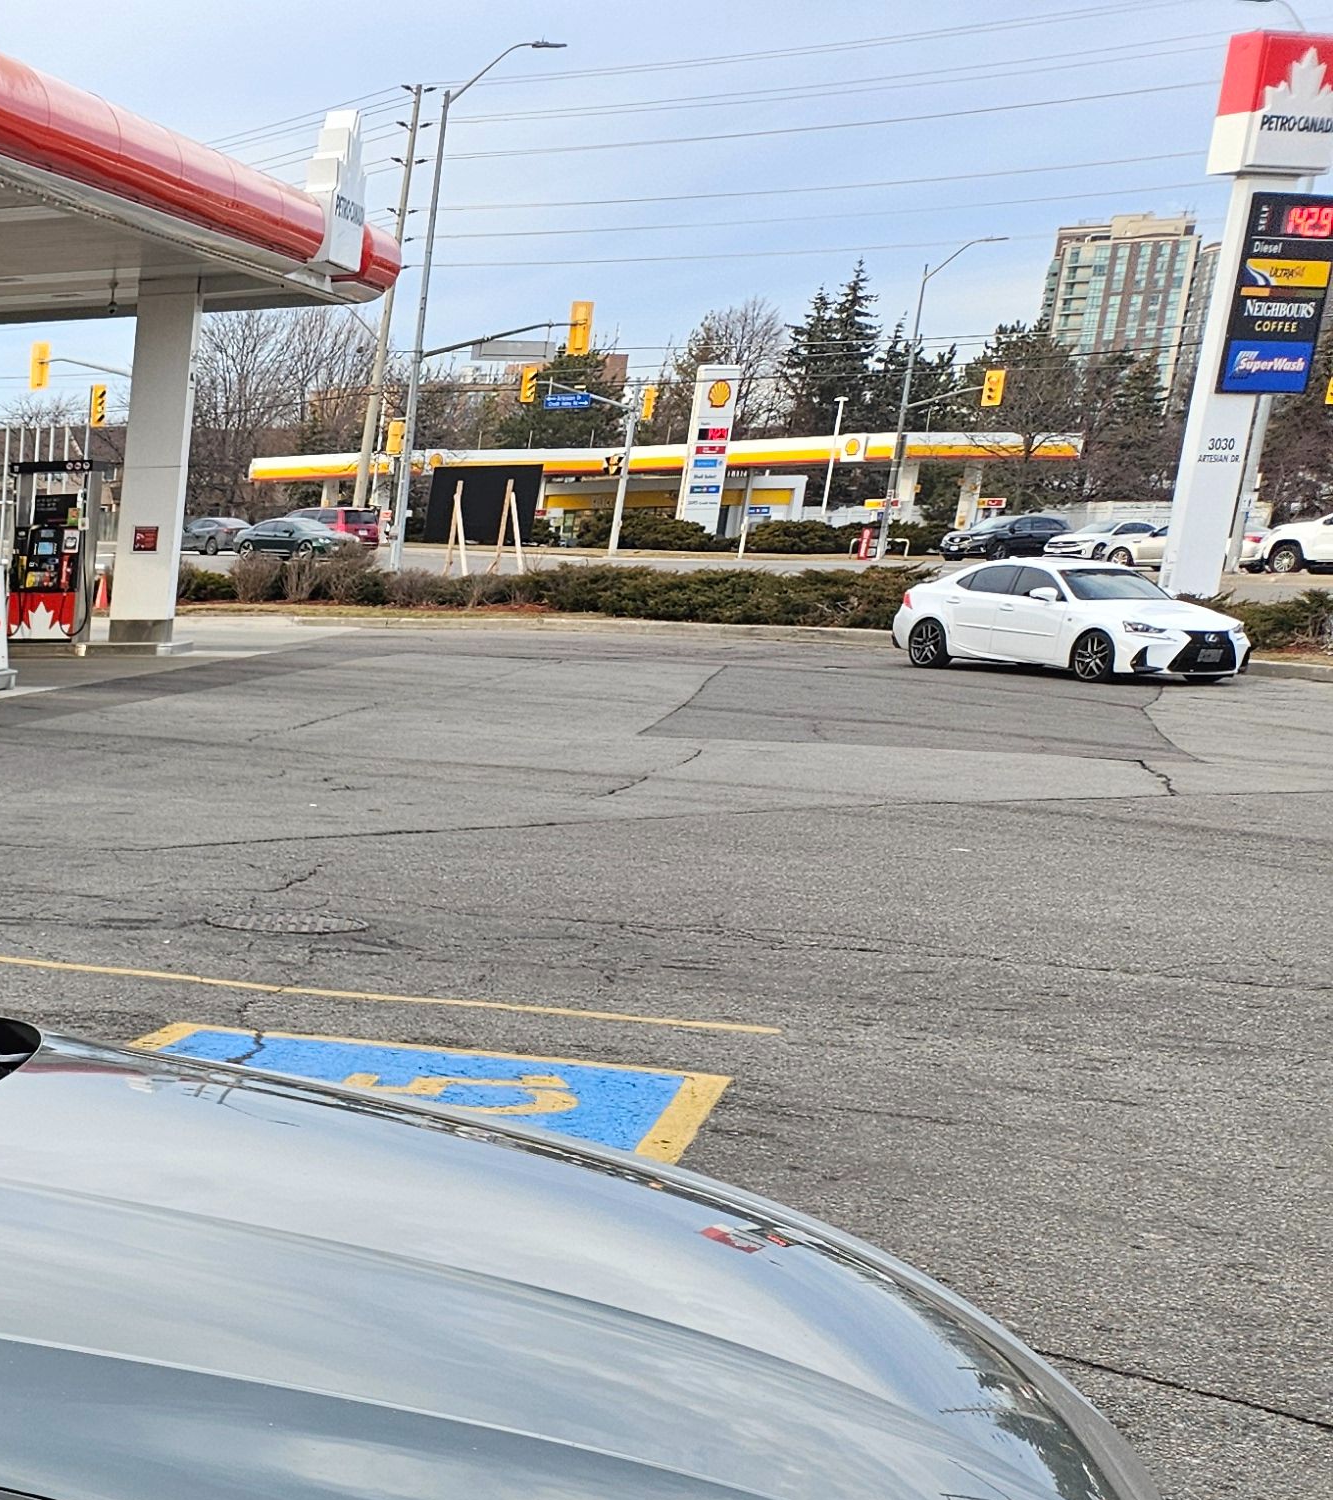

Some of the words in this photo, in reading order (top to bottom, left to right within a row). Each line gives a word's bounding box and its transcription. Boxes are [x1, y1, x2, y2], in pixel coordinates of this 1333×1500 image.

[1253, 241, 1283, 254] Diesel
[1244, 299, 1316, 319] NEIGHBOURS
[1254, 320, 1298, 333] COFFEE
[1238, 356, 1306, 373] SuperWash
[1208, 437, 1235, 451] 3030
[1197, 454, 1229, 463] ARTESIAN
